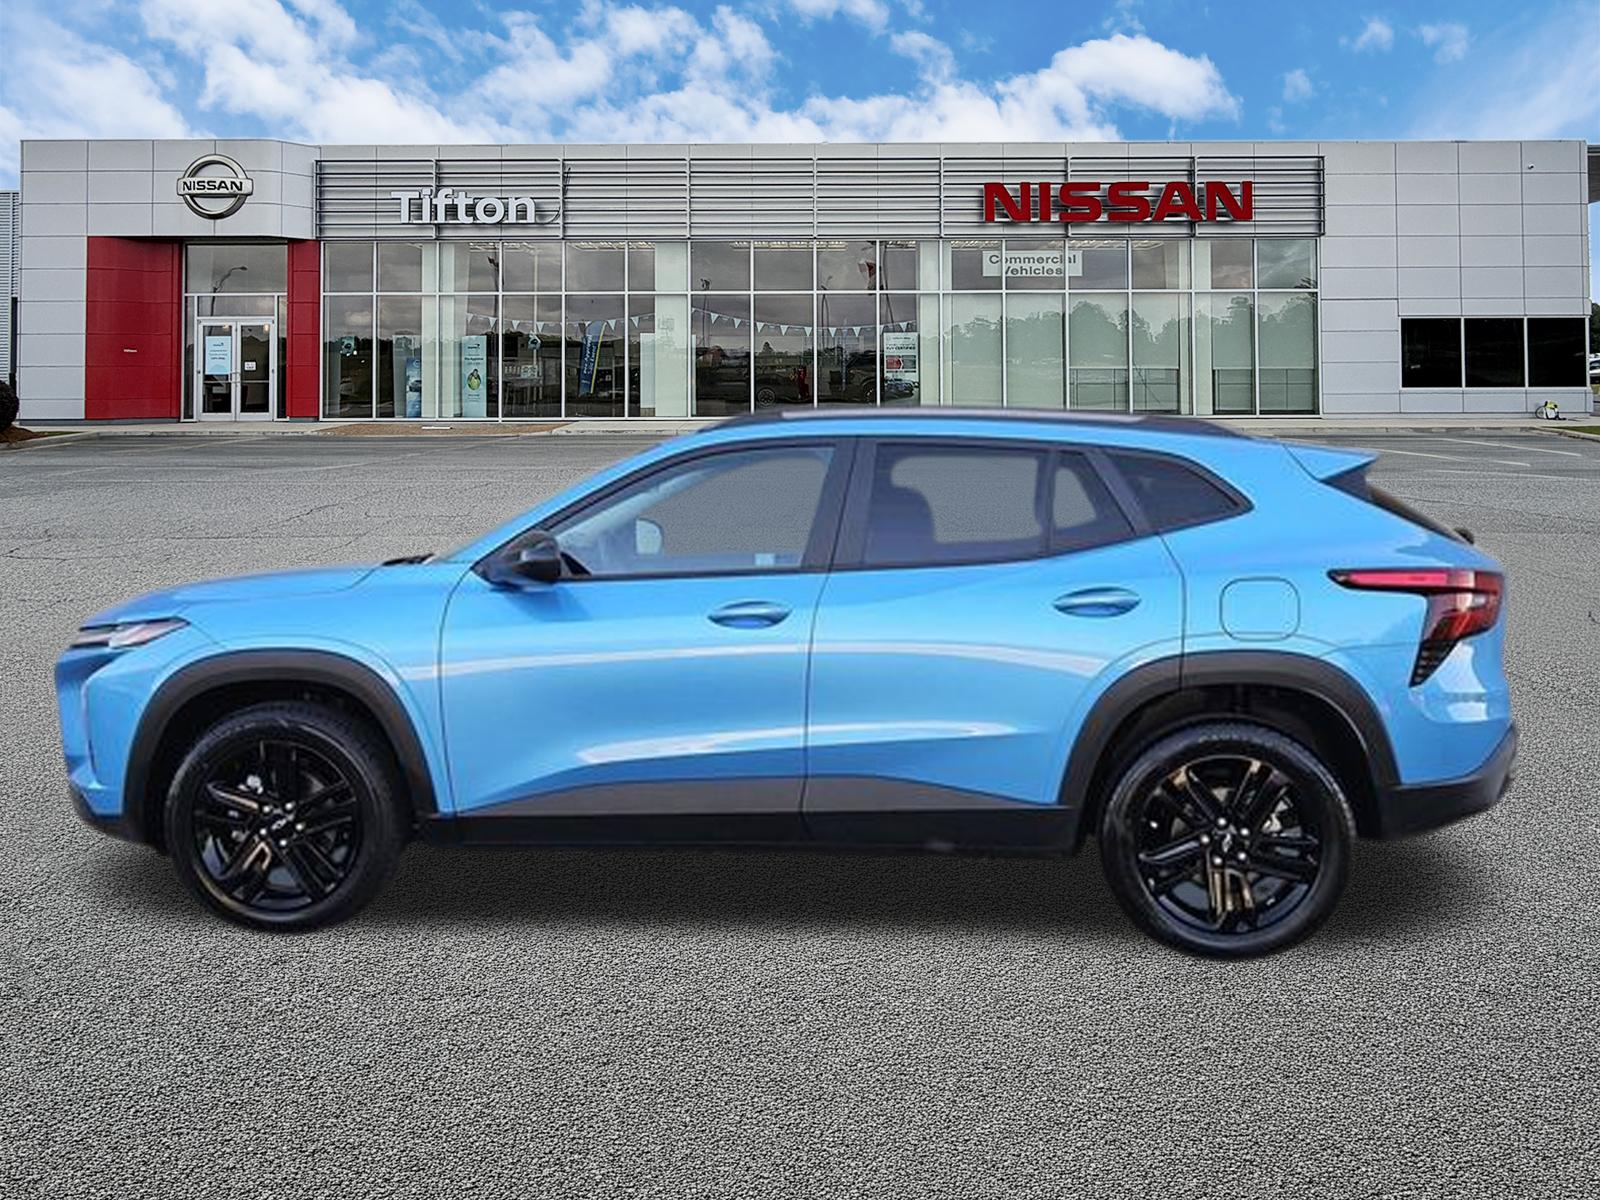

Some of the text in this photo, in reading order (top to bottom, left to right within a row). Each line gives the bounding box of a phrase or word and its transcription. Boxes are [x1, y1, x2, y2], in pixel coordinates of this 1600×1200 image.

[183, 180, 243, 191] NISSAN
[983, 181, 1253, 222] NISSAN
[390, 187, 536, 224] Tifton
